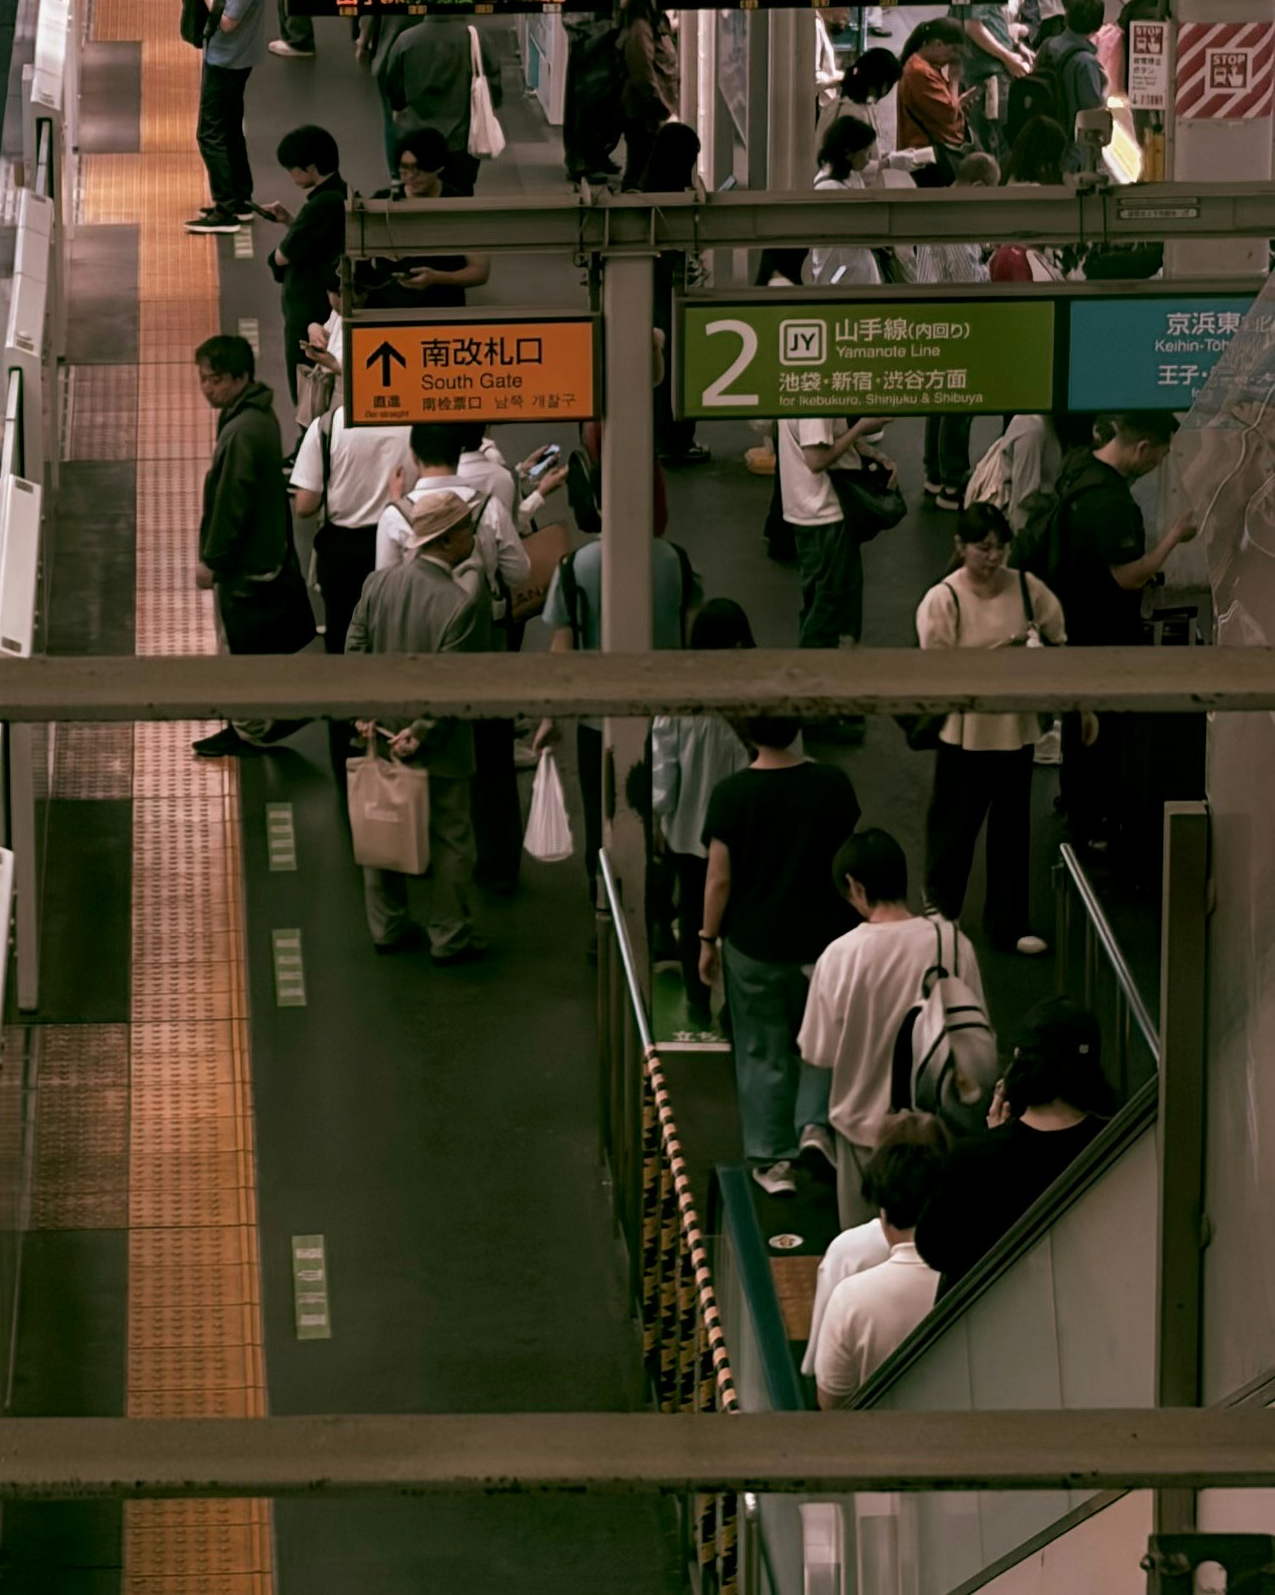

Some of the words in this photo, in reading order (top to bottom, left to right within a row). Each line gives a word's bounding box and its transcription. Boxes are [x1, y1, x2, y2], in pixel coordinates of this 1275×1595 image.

[1135, 26, 1163, 35] STOP
[1212, 54, 1245, 65] STOP
[835, 318, 971, 342] 山手線(内回り)
[789, 332, 817, 352] JY
[420, 337, 543, 367] 南改札口
[835, 345, 907, 359] Yamanote
[910, 344, 941, 358] Line
[701, 319, 759, 407] 2
[421, 373, 473, 390] South
[479, 372, 523, 389] Gate
[779, 394, 796, 407] for
[865, 392, 918, 407] Shinjuku
[921, 392, 931, 404] &
[933, 391, 984, 406] Shibuya
